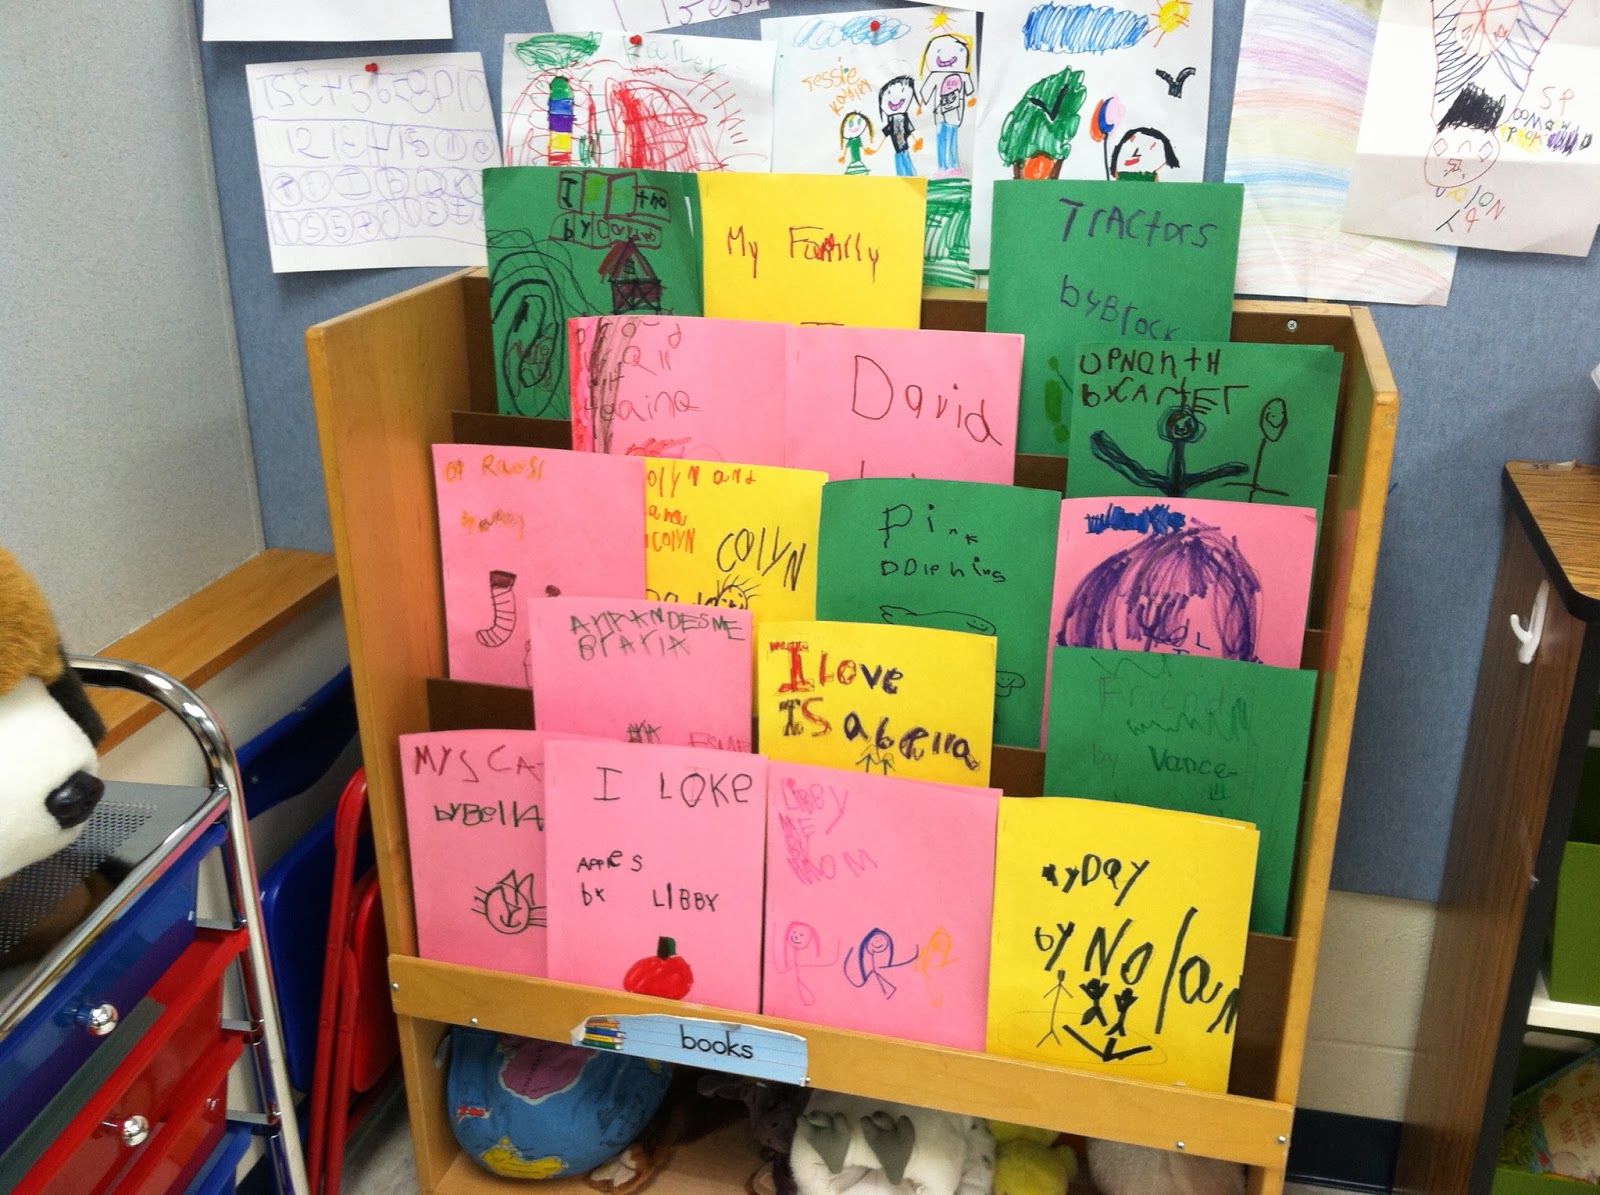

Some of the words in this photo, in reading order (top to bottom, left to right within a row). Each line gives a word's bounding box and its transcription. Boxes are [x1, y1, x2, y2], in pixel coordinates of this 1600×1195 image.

[728, 225, 758, 279] My
[852, 355, 1003, 446] David
[593, 766, 622, 801] I
[679, 1023, 755, 1060] books
